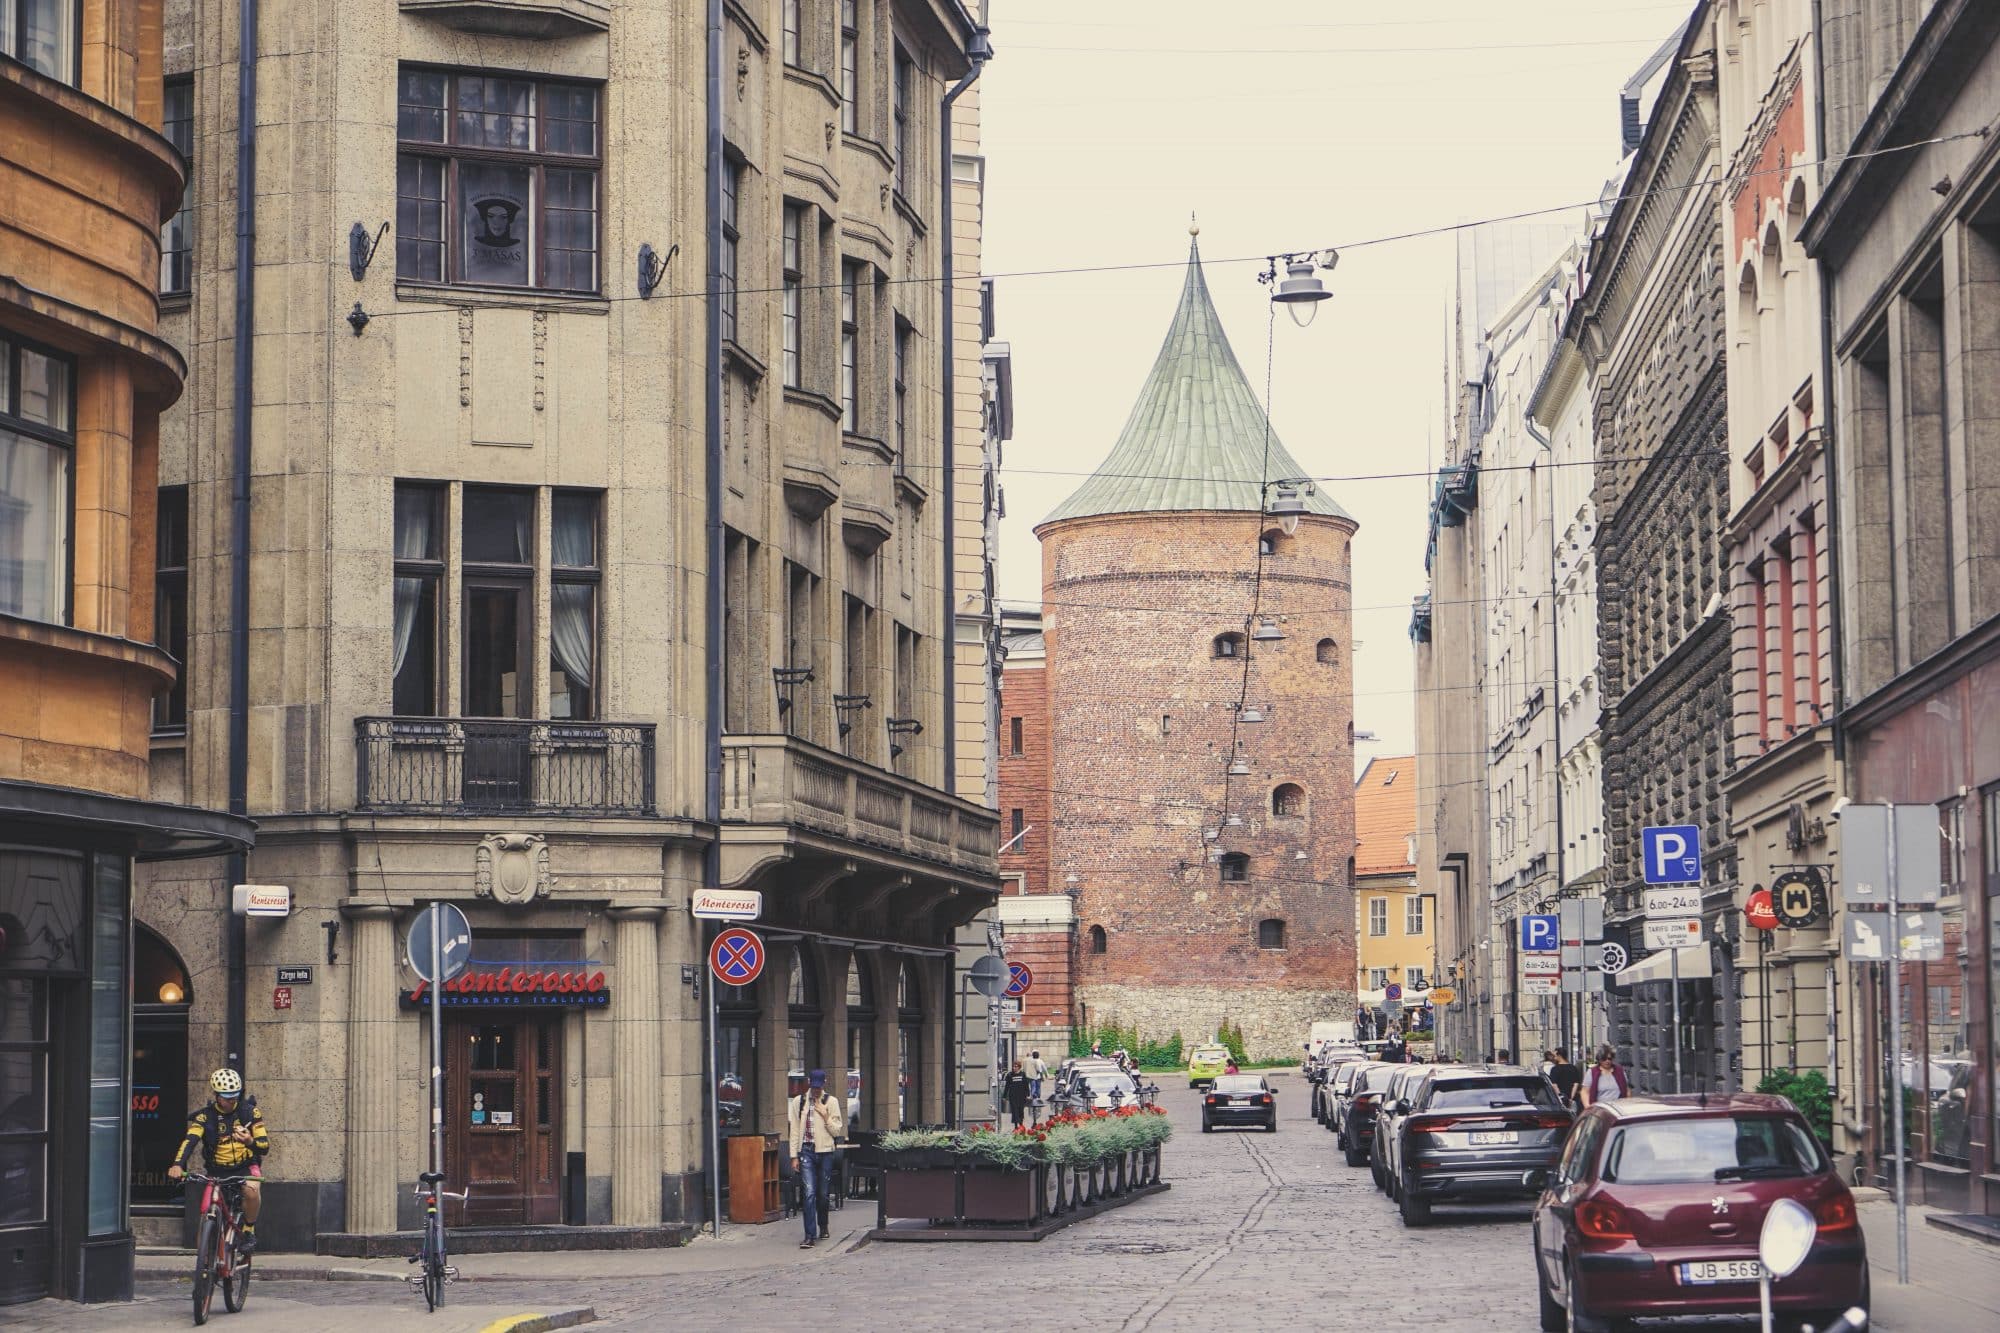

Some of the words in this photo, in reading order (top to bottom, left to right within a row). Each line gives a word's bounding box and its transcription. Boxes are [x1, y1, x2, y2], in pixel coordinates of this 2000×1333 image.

[1655, 833, 1686, 876] P
[250, 894, 287, 905] Monterosso
[701, 897, 756, 910] Monterosso
[1749, 902, 1775, 916] Leic
[1529, 919, 1550, 947] P
[423, 996, 519, 1005] RSTORANTE
[533, 996, 605, 1004] ITALIANO
